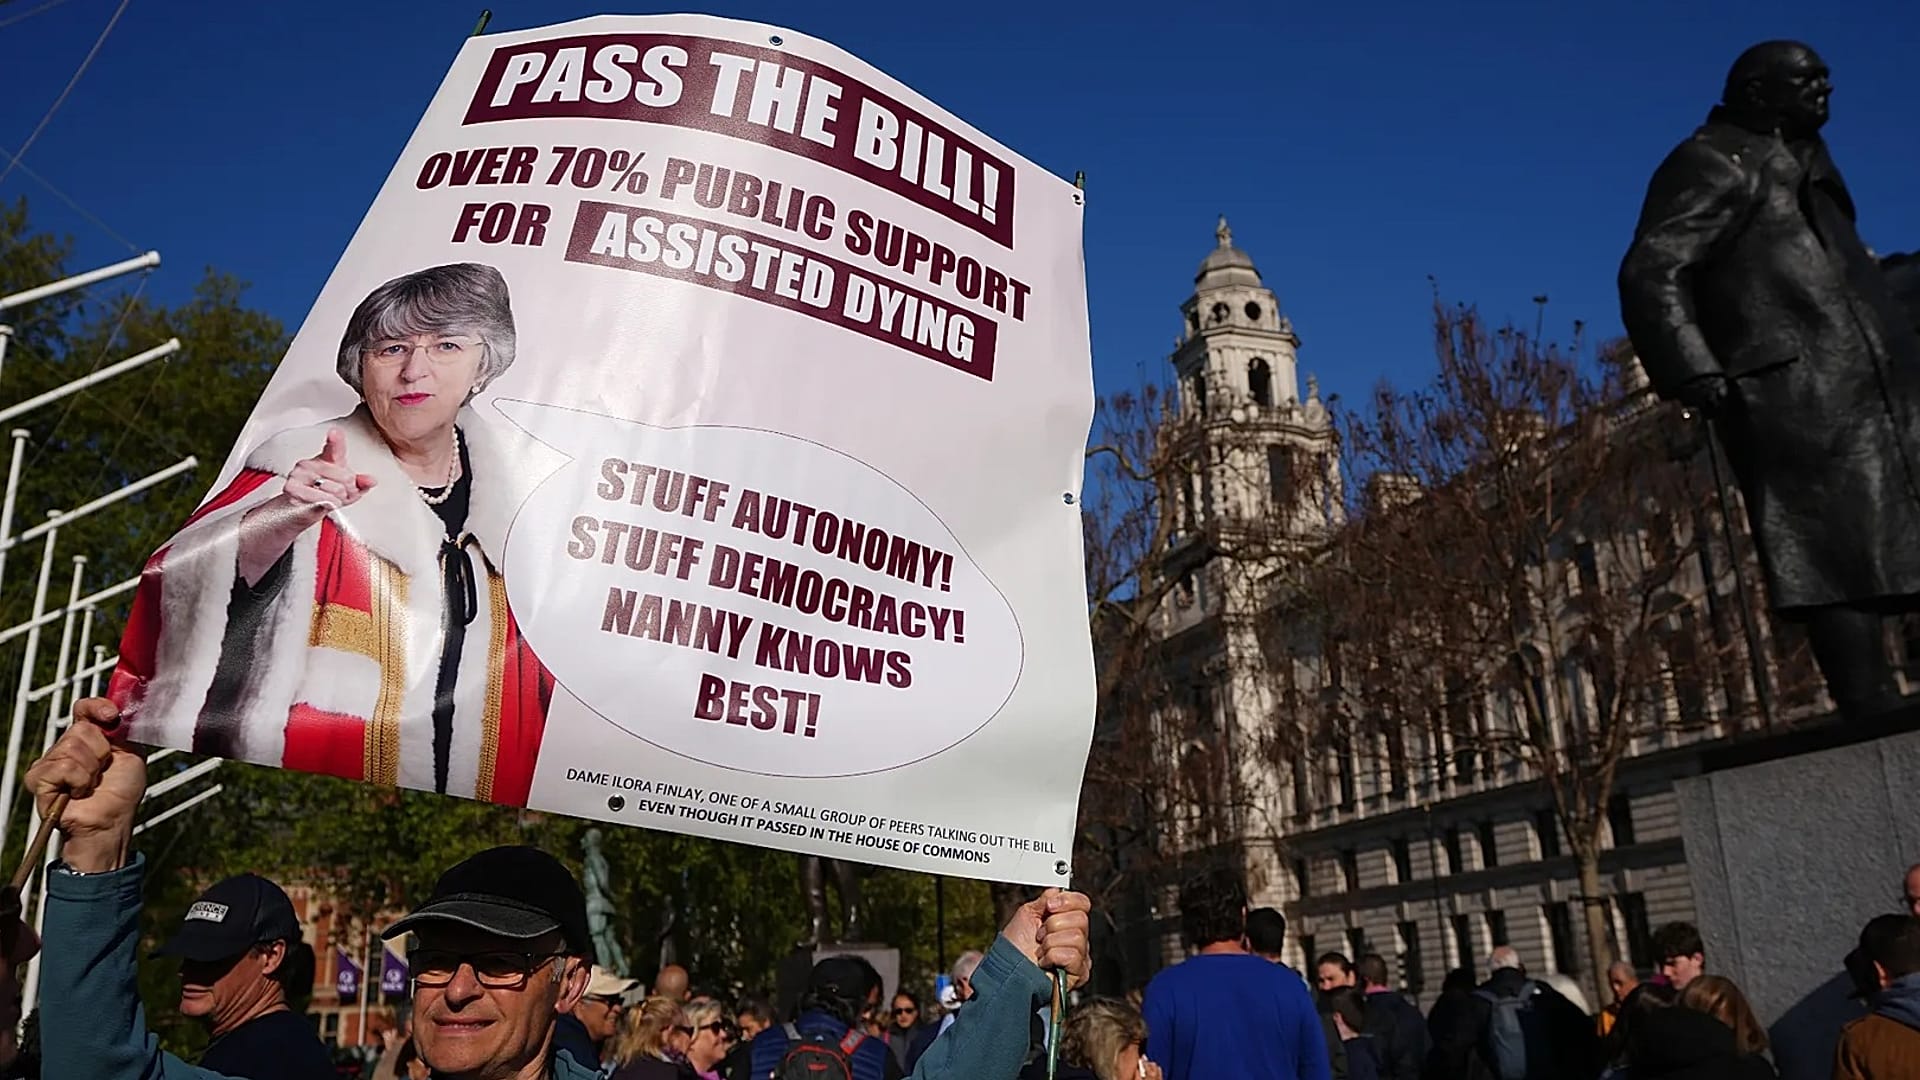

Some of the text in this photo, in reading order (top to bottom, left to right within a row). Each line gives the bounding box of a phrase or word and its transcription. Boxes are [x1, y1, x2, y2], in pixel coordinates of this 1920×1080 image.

[490, 44, 999, 225] PASS THE BILL!
[415, 147, 1031, 321] OVER 70% PUBLIC SUPPORT
[451, 203, 975, 363] FOR ASSISTED DYING
[567, 515, 965, 643] STUFF DEMOCRACY!
[597, 457, 954, 593] STUFF AUTONOMY!
[600, 587, 913, 689] NANNY KNOWS
[694, 673, 821, 738] BEST!
[566, 768, 1056, 854] DAME ILORA FINLAY, ONE OF A SMALL GROUP OF PEERS TALKING OUT THE BILL
[638, 800, 991, 864] EVEN THOUGH IT PASSED IN THE HOUSE OF COMMONS
